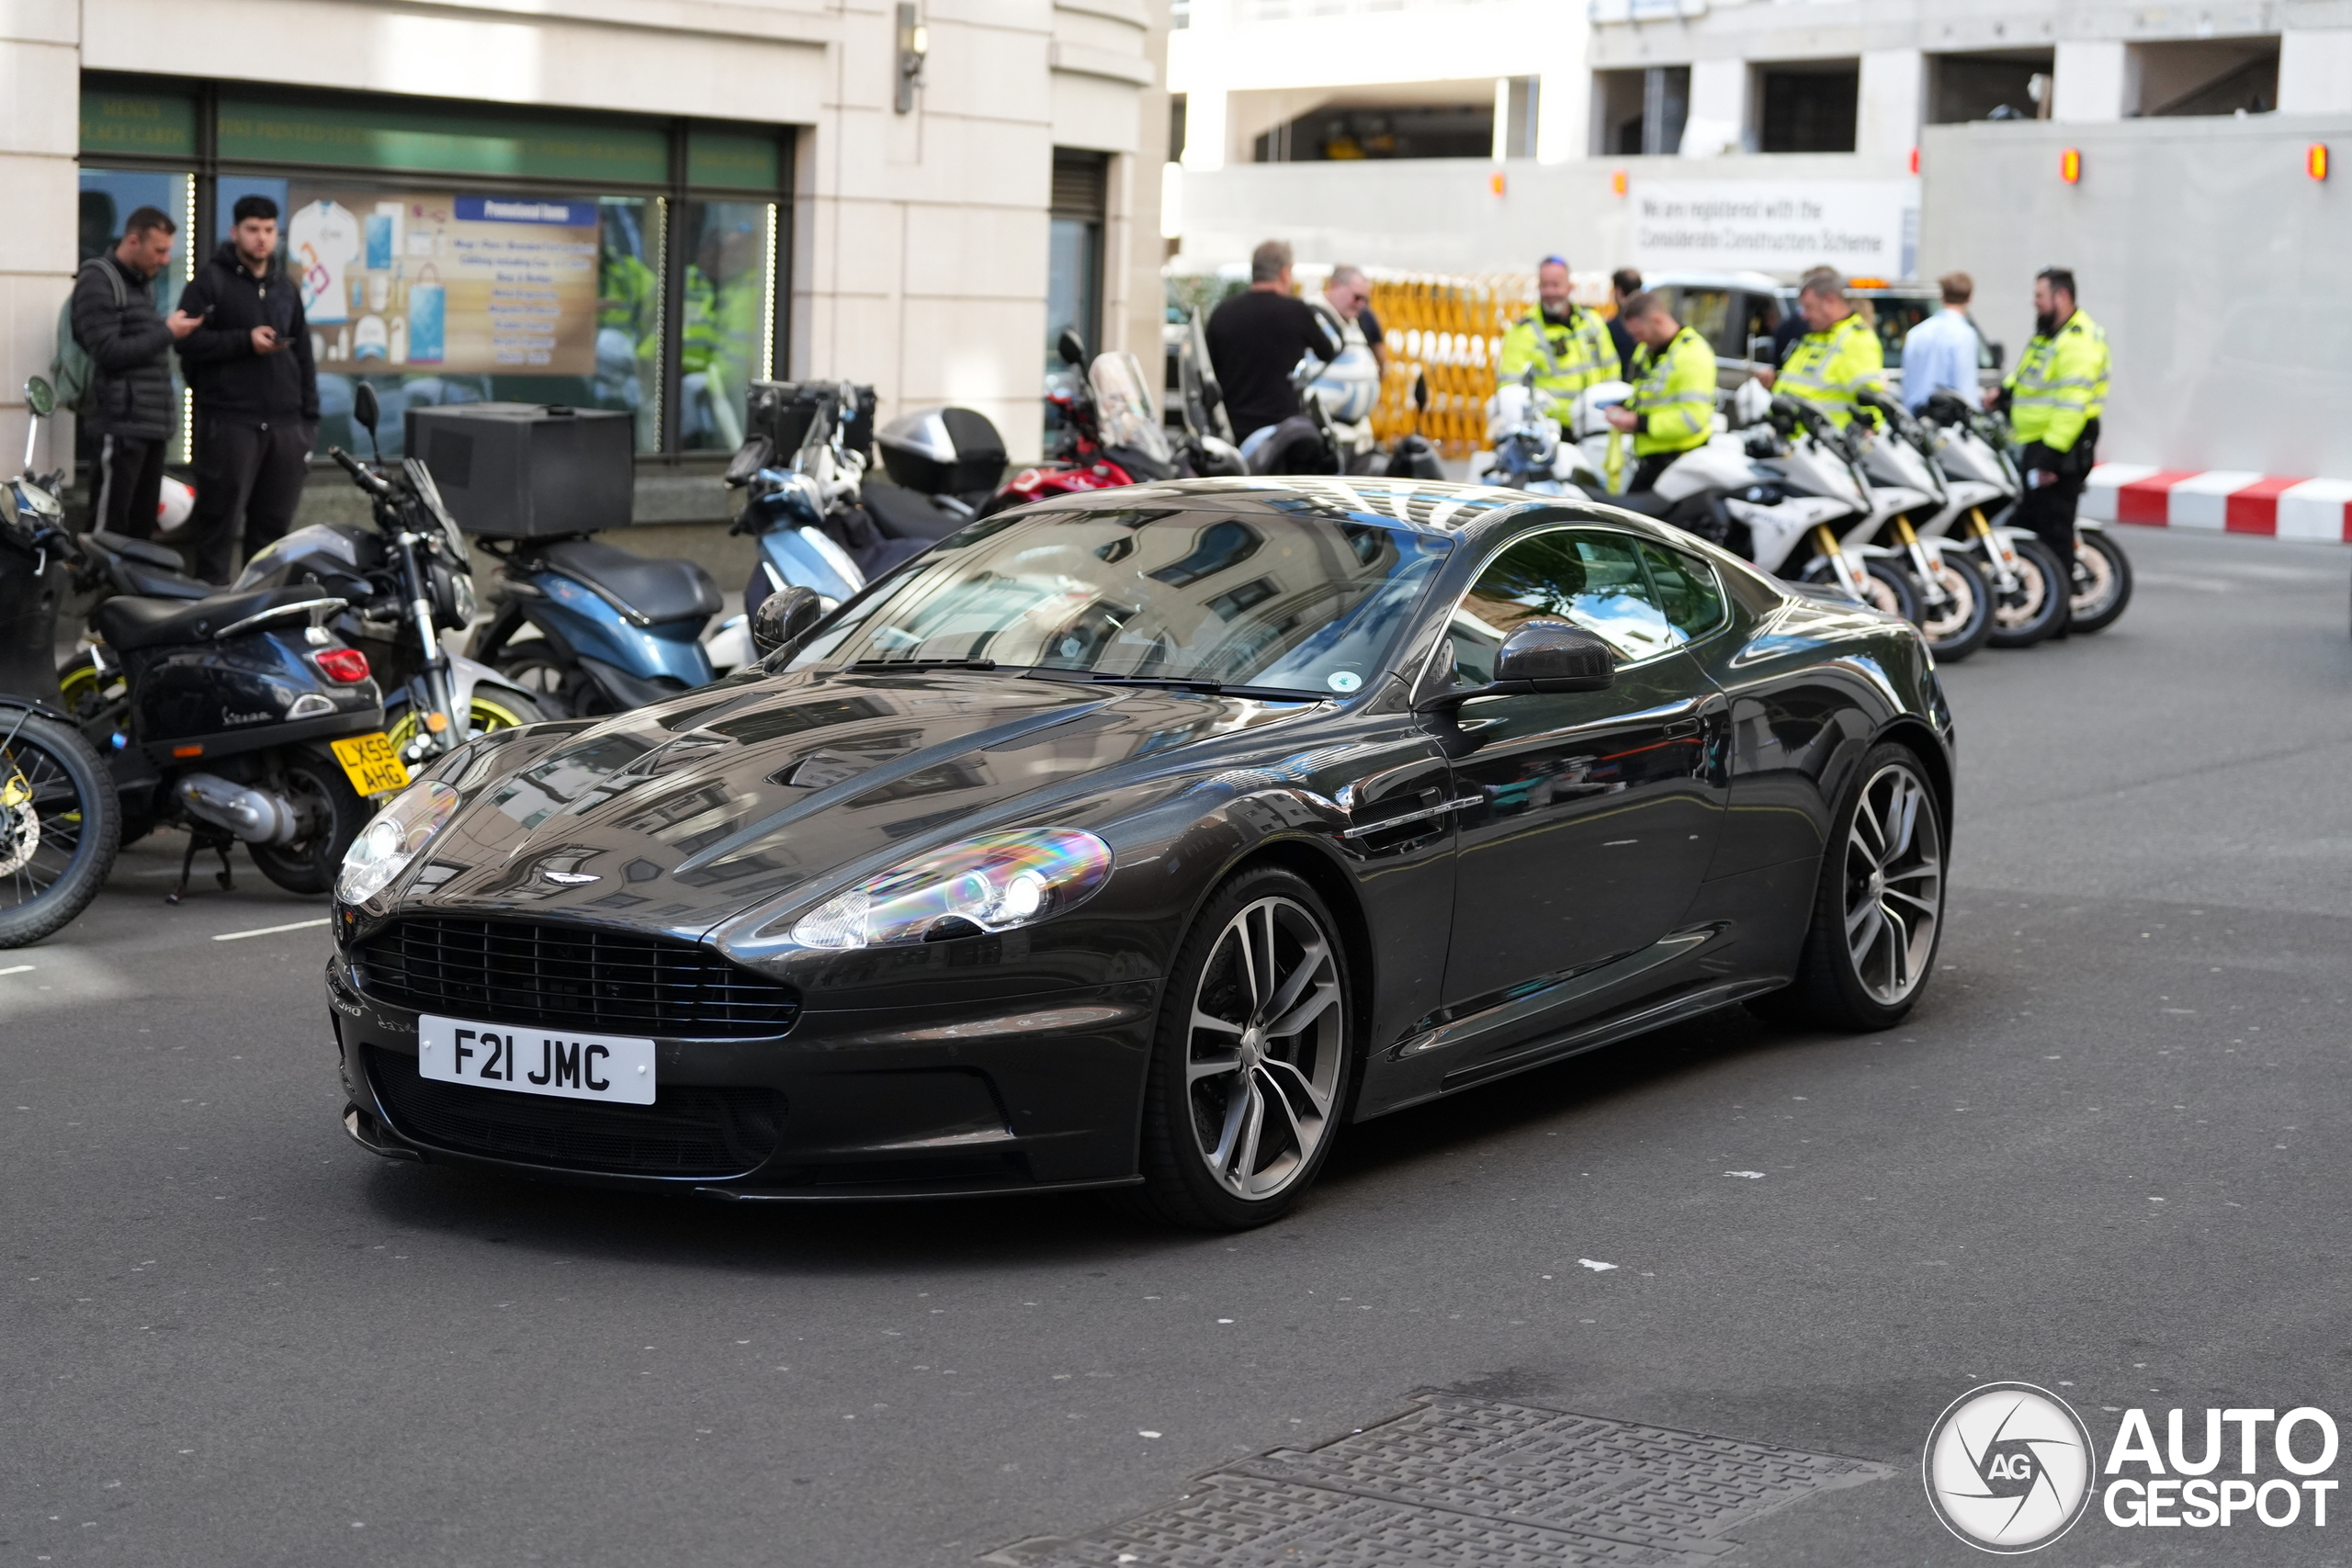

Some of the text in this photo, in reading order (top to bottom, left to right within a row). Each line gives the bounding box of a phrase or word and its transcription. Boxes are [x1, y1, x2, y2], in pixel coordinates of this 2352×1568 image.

[1642, 199, 1823, 221] We are registered with the
[1640, 229, 1883, 254] Considerate Constructors Scheme
[337, 738, 395, 768] LX59
[362, 764, 402, 791] AHG
[455, 1028, 610, 1091] F21 JMC
